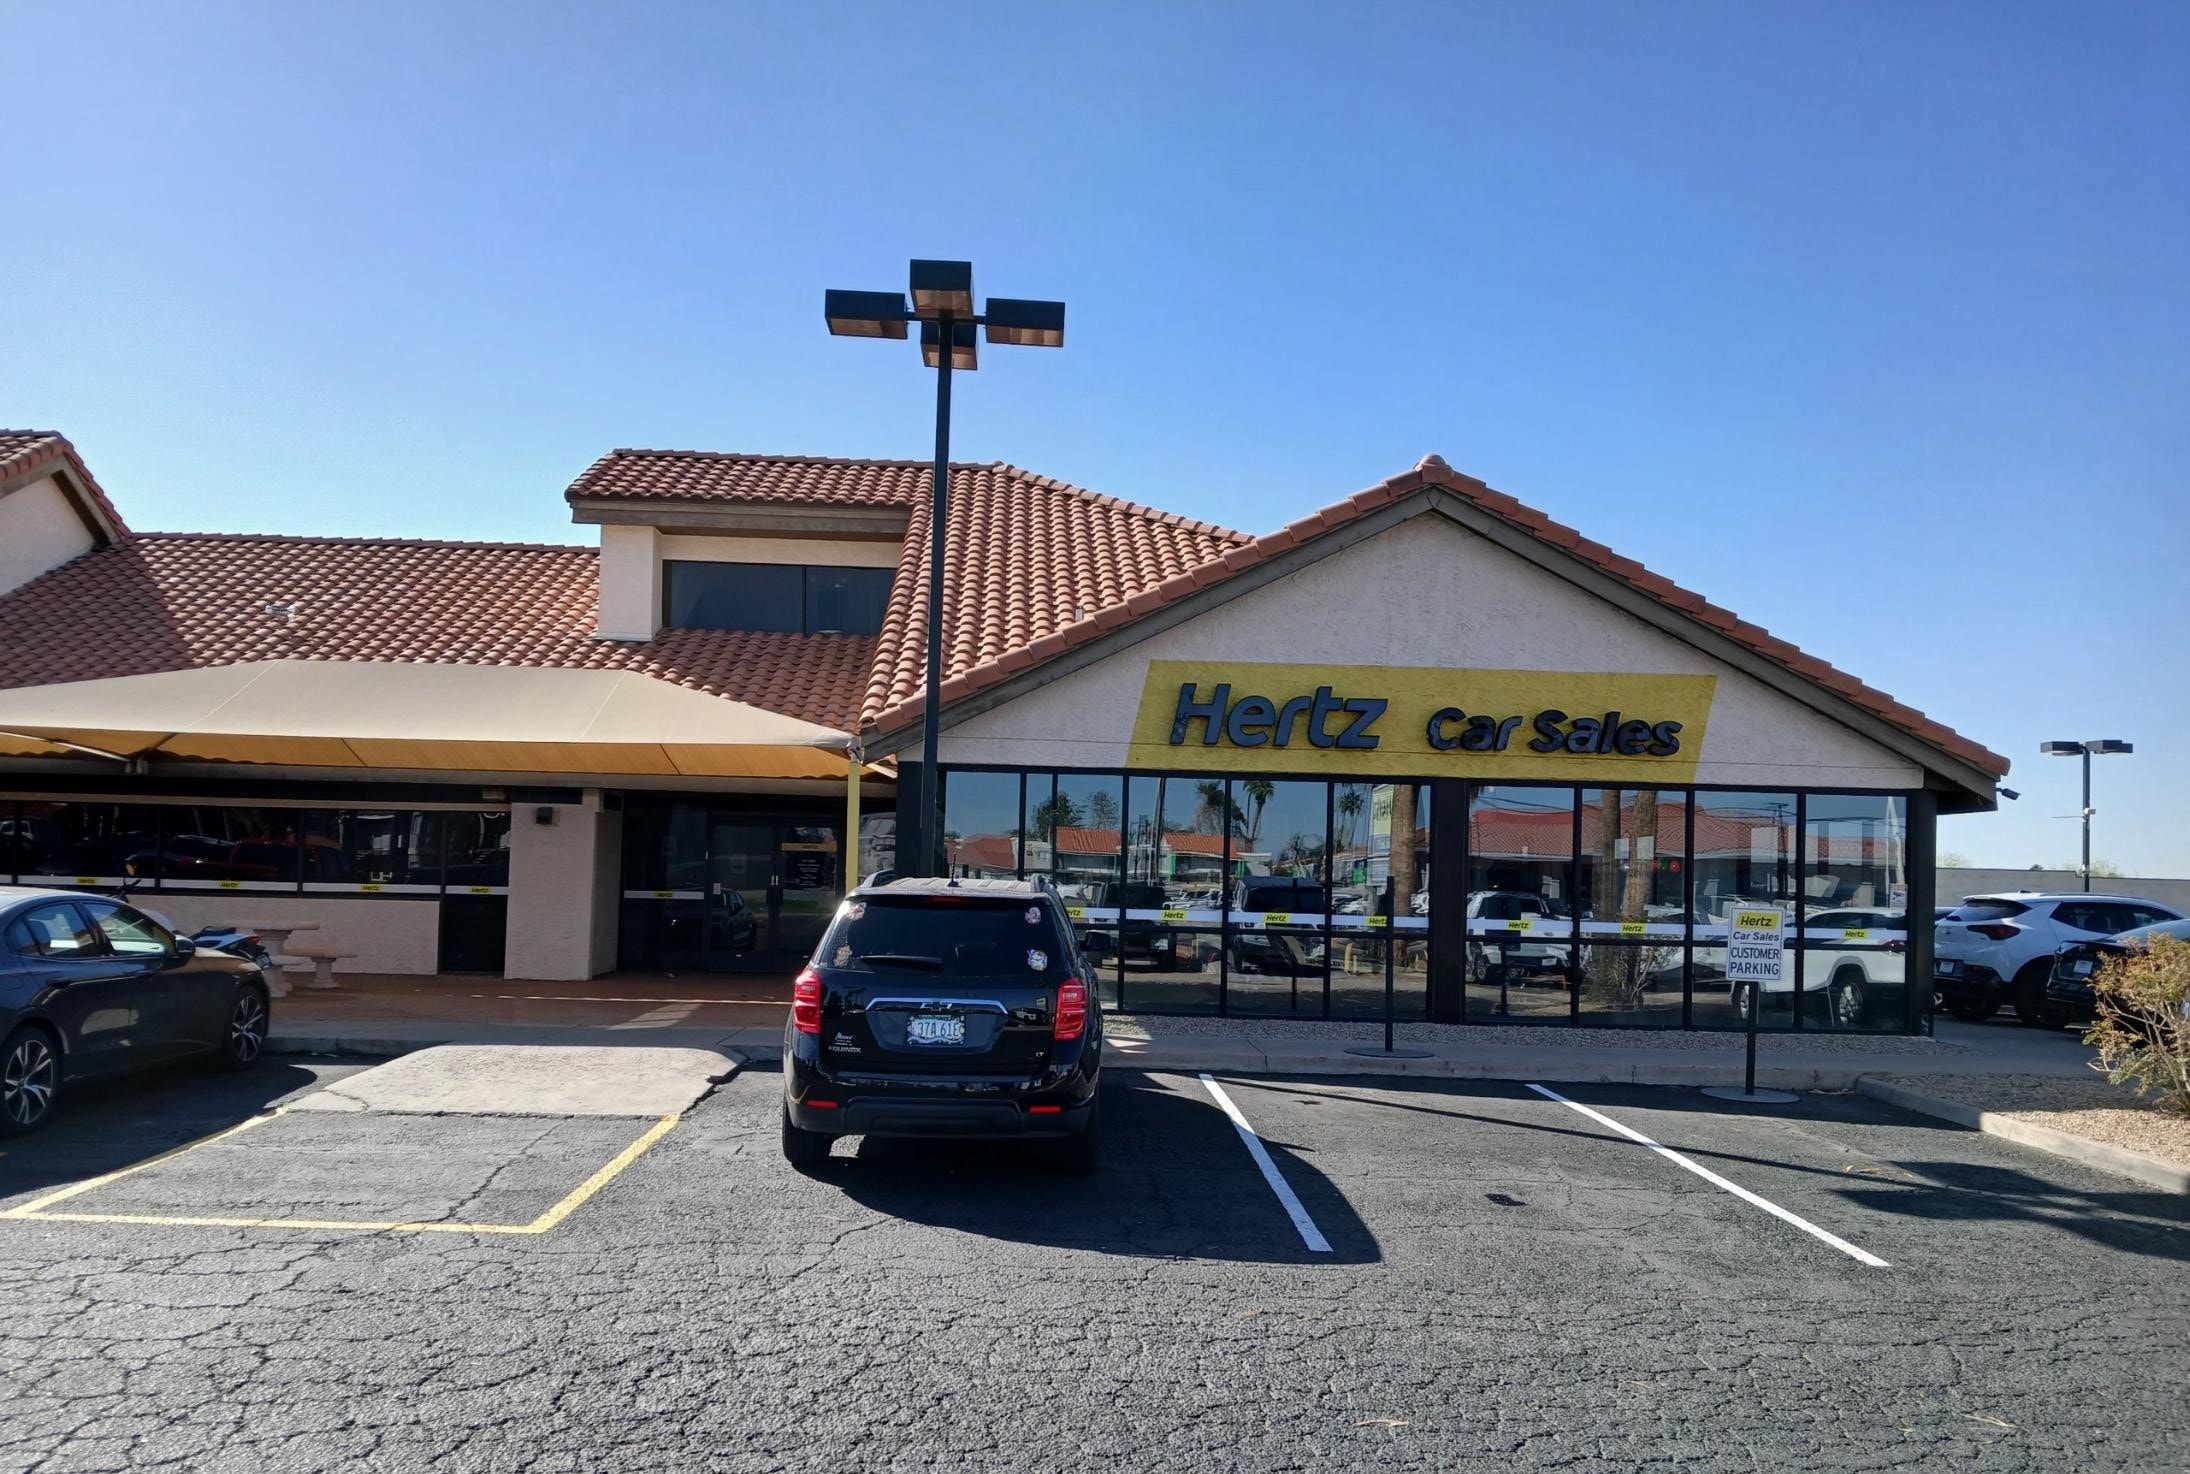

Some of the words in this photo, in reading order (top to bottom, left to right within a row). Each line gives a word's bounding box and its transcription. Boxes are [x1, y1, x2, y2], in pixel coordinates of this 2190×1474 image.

[1169, 682, 1389, 749] Hertz
[1426, 706, 1524, 751] Car
[1527, 709, 1684, 757] Sales
[1164, 911, 1184, 919] Hertz
[1369, 917, 1387, 925] Hert
[1508, 921, 1529, 929] Hertz
[1740, 916, 1773, 927] Hertz
[1623, 924, 1643, 932] Hertz
[1733, 931, 1751, 941] Car
[1752, 931, 1780, 942] Sales
[1845, 930, 1865, 938] Hertz
[1731, 946, 1780, 960] CUSTOMER
[1730, 961, 1779, 976] PARKING
